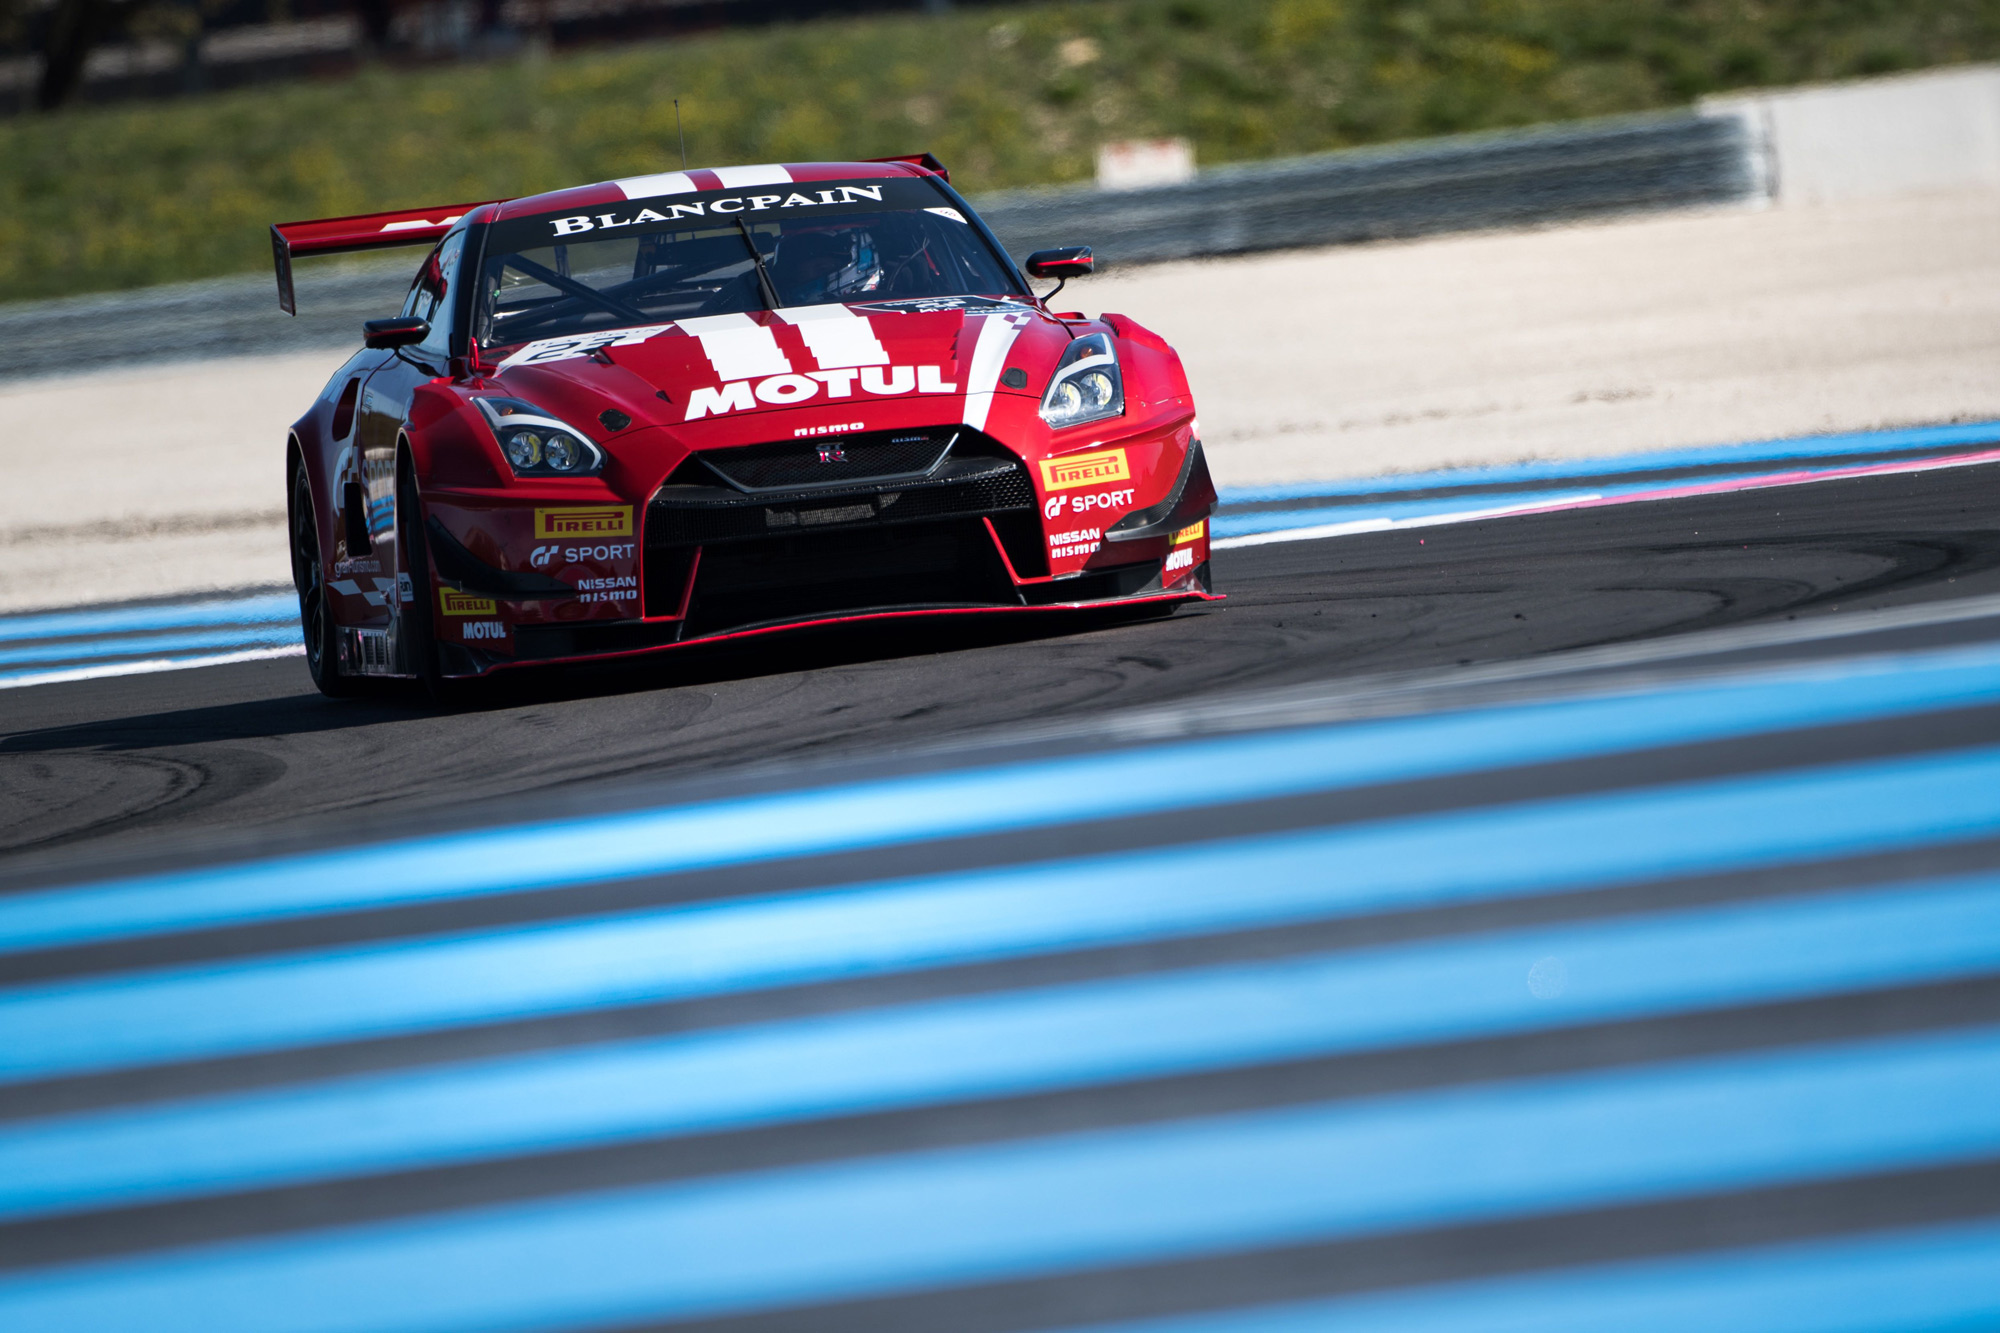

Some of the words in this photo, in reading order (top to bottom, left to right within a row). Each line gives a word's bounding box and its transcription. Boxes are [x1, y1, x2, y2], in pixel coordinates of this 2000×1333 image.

[549, 184, 883, 237] BLANCPAIN
[684, 364, 957, 421] MOTUL
[1049, 455, 1120, 484] PIRELLI
[1072, 488, 1135, 513] SPORT
[545, 511, 625, 533] PIRELLI
[1050, 528, 1101, 546] NISSAN
[565, 543, 635, 563] SPORT
[1166, 547, 1194, 572] MOTUL
[578, 576, 636, 590] NISSAN
[445, 593, 491, 611] PIRELLI
[463, 621, 507, 639] MOTUL
